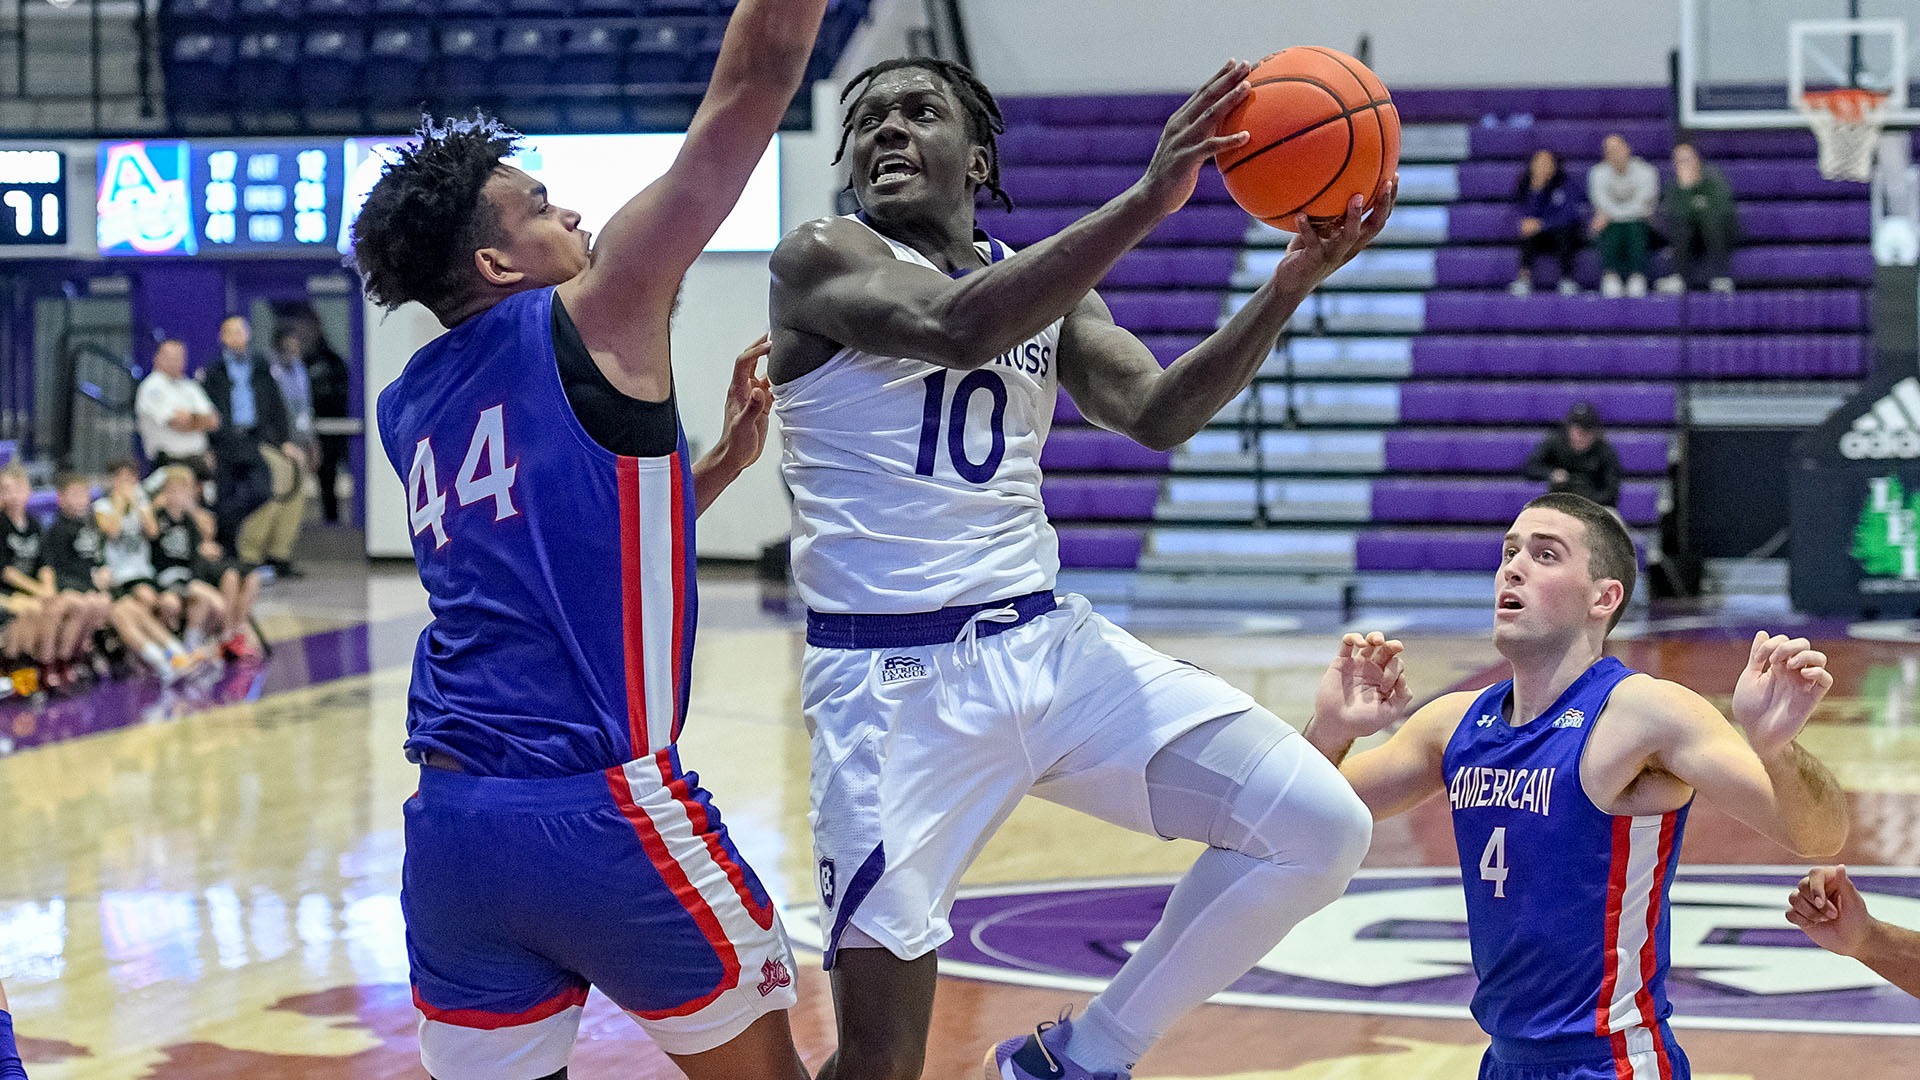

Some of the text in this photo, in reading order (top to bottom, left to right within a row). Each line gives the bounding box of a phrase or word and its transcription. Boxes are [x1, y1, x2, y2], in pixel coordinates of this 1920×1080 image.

[3, 190, 59, 237] 71
[915, 368, 1007, 484] 10
[408, 403, 521, 551] 44
[882, 664, 926, 677] PATRIOT
[883, 670, 927, 682] LEAGUE
[1449, 766, 1556, 817] AMERICAN
[1479, 826, 1509, 898] 4
